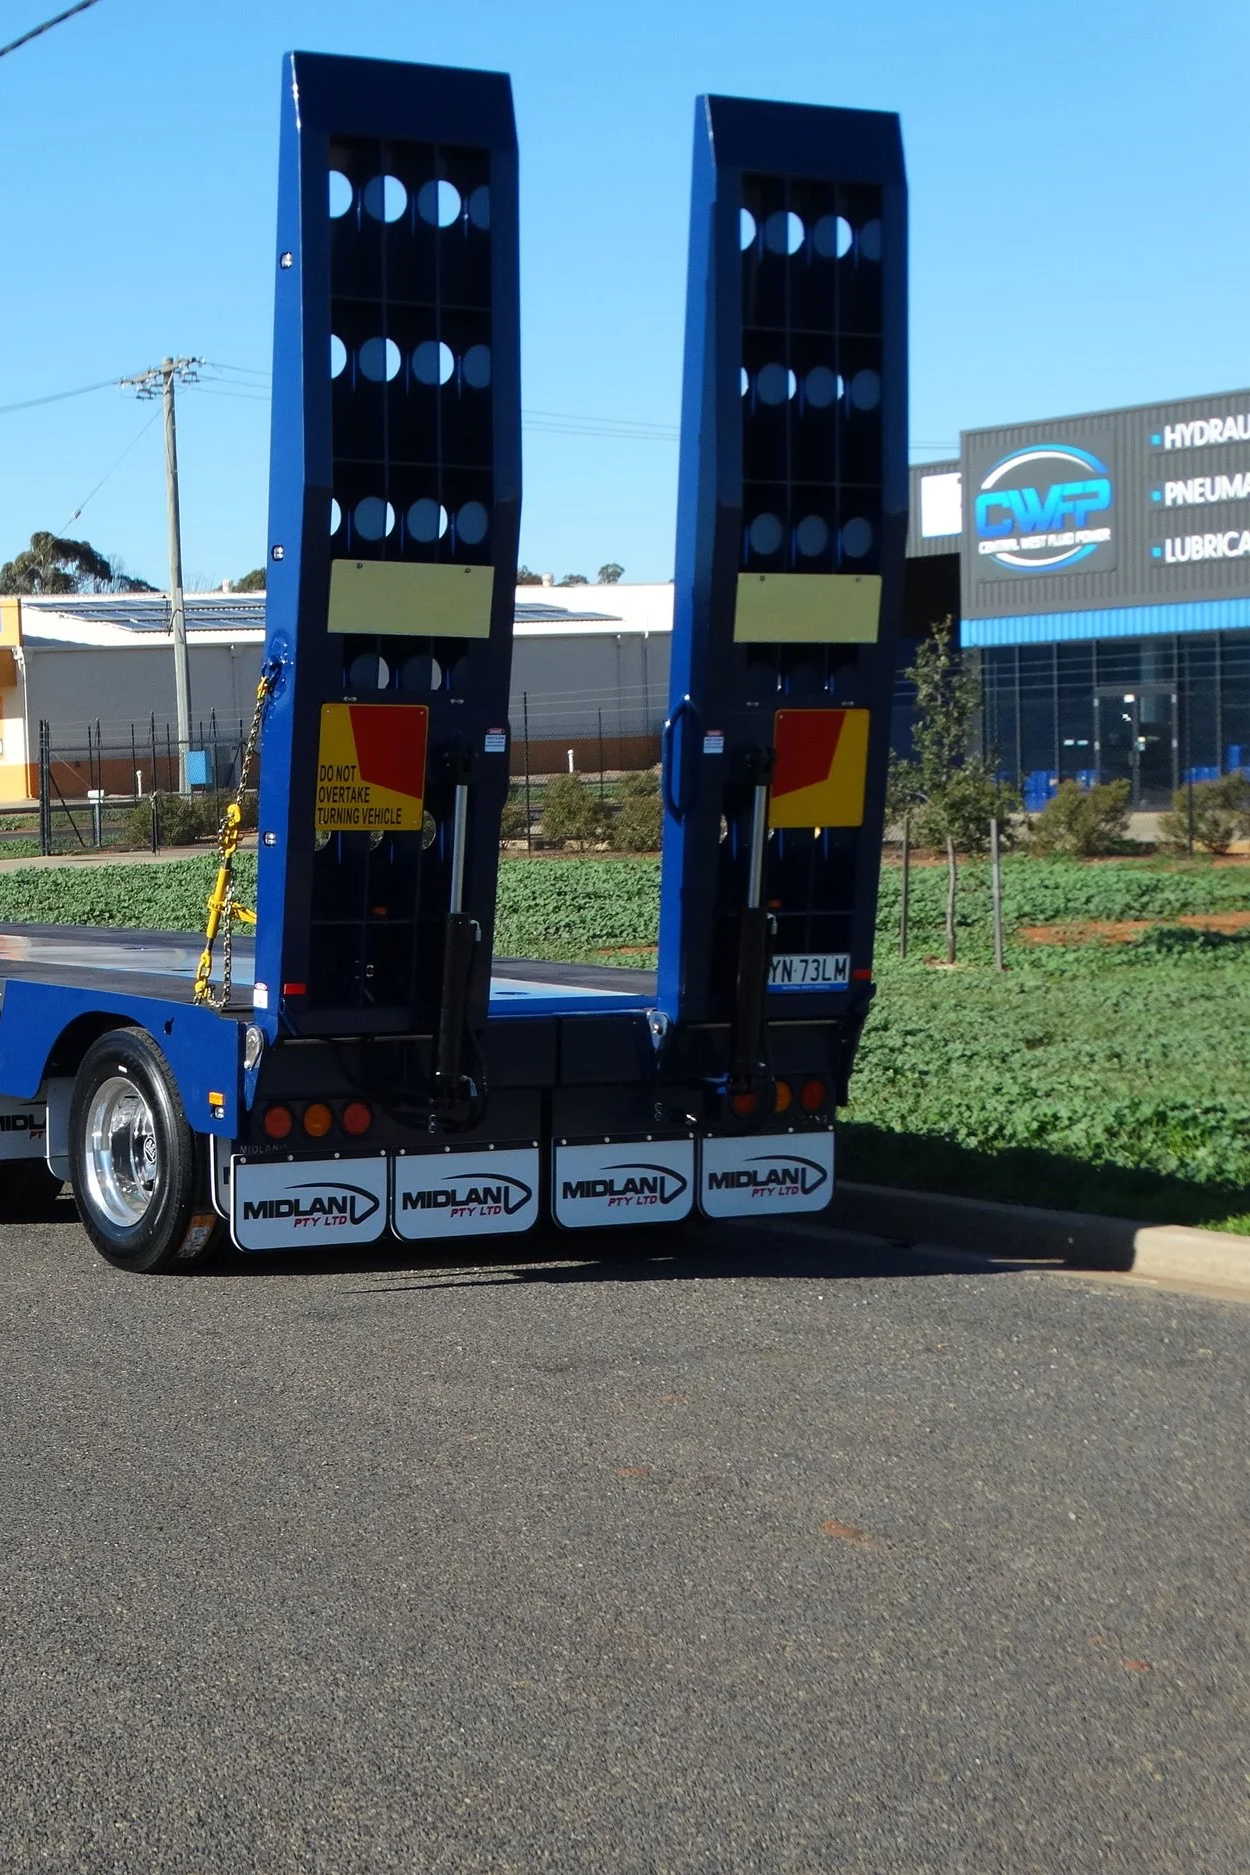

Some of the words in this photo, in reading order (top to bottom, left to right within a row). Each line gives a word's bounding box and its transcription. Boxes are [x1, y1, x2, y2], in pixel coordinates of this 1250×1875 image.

[976, 479, 1111, 537] CWFP
[319, 765, 334, 781] DO
[336, 765, 357, 781] NOT
[318, 786, 370, 803] OVERTAKE
[318, 807, 360, 824] TURNING
[362, 808, 402, 824] VEHICLE
[752, 1187, 778, 1198] PTY
[778, 1186, 799, 1196] LTD
[608, 1196, 635, 1207] PTY
[636, 1195, 658, 1205] LTD
[450, 1206, 477, 1218] PTY
[480, 1206, 502, 1216] LTD
[294, 1216, 322, 1228] PTY
[324, 1216, 348, 1226] LTD
